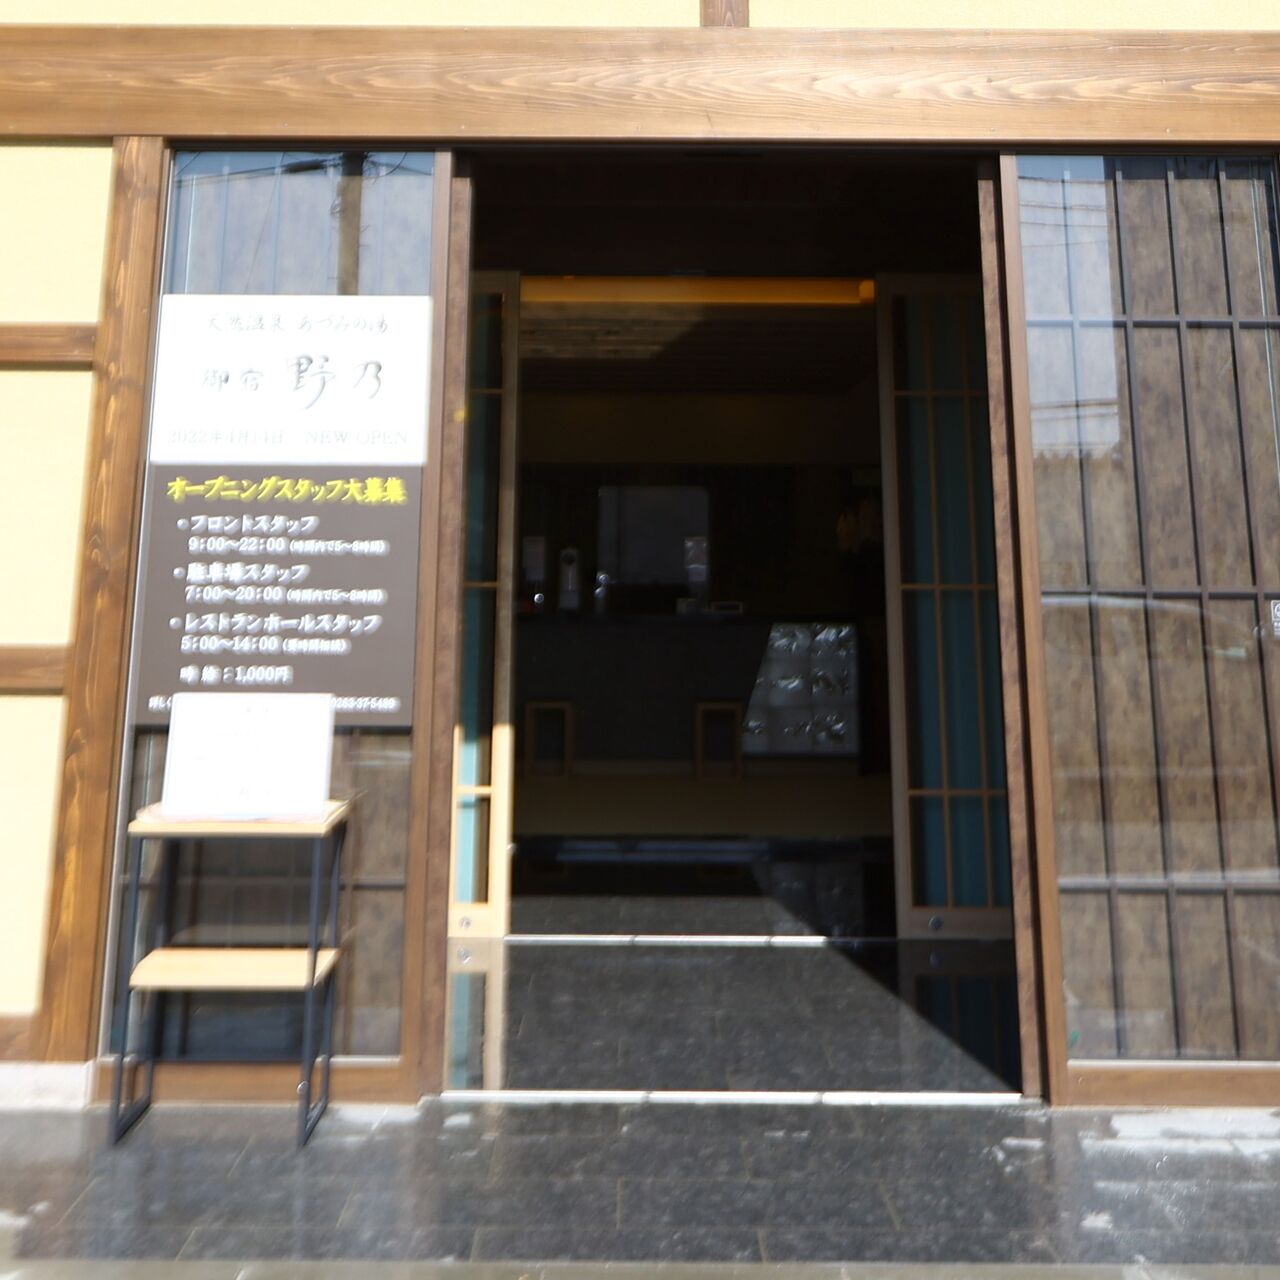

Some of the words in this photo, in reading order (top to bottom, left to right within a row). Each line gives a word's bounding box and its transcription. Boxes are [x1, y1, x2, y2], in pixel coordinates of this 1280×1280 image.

[305, 431, 348, 444] NEW
[356, 431, 409, 445] OPEN
[167, 476, 408, 504] オープニングスタッフ大募集
[190, 515, 320, 535] フロントスタッフ
[185, 612, 382, 635] レストランホールスタッフ
